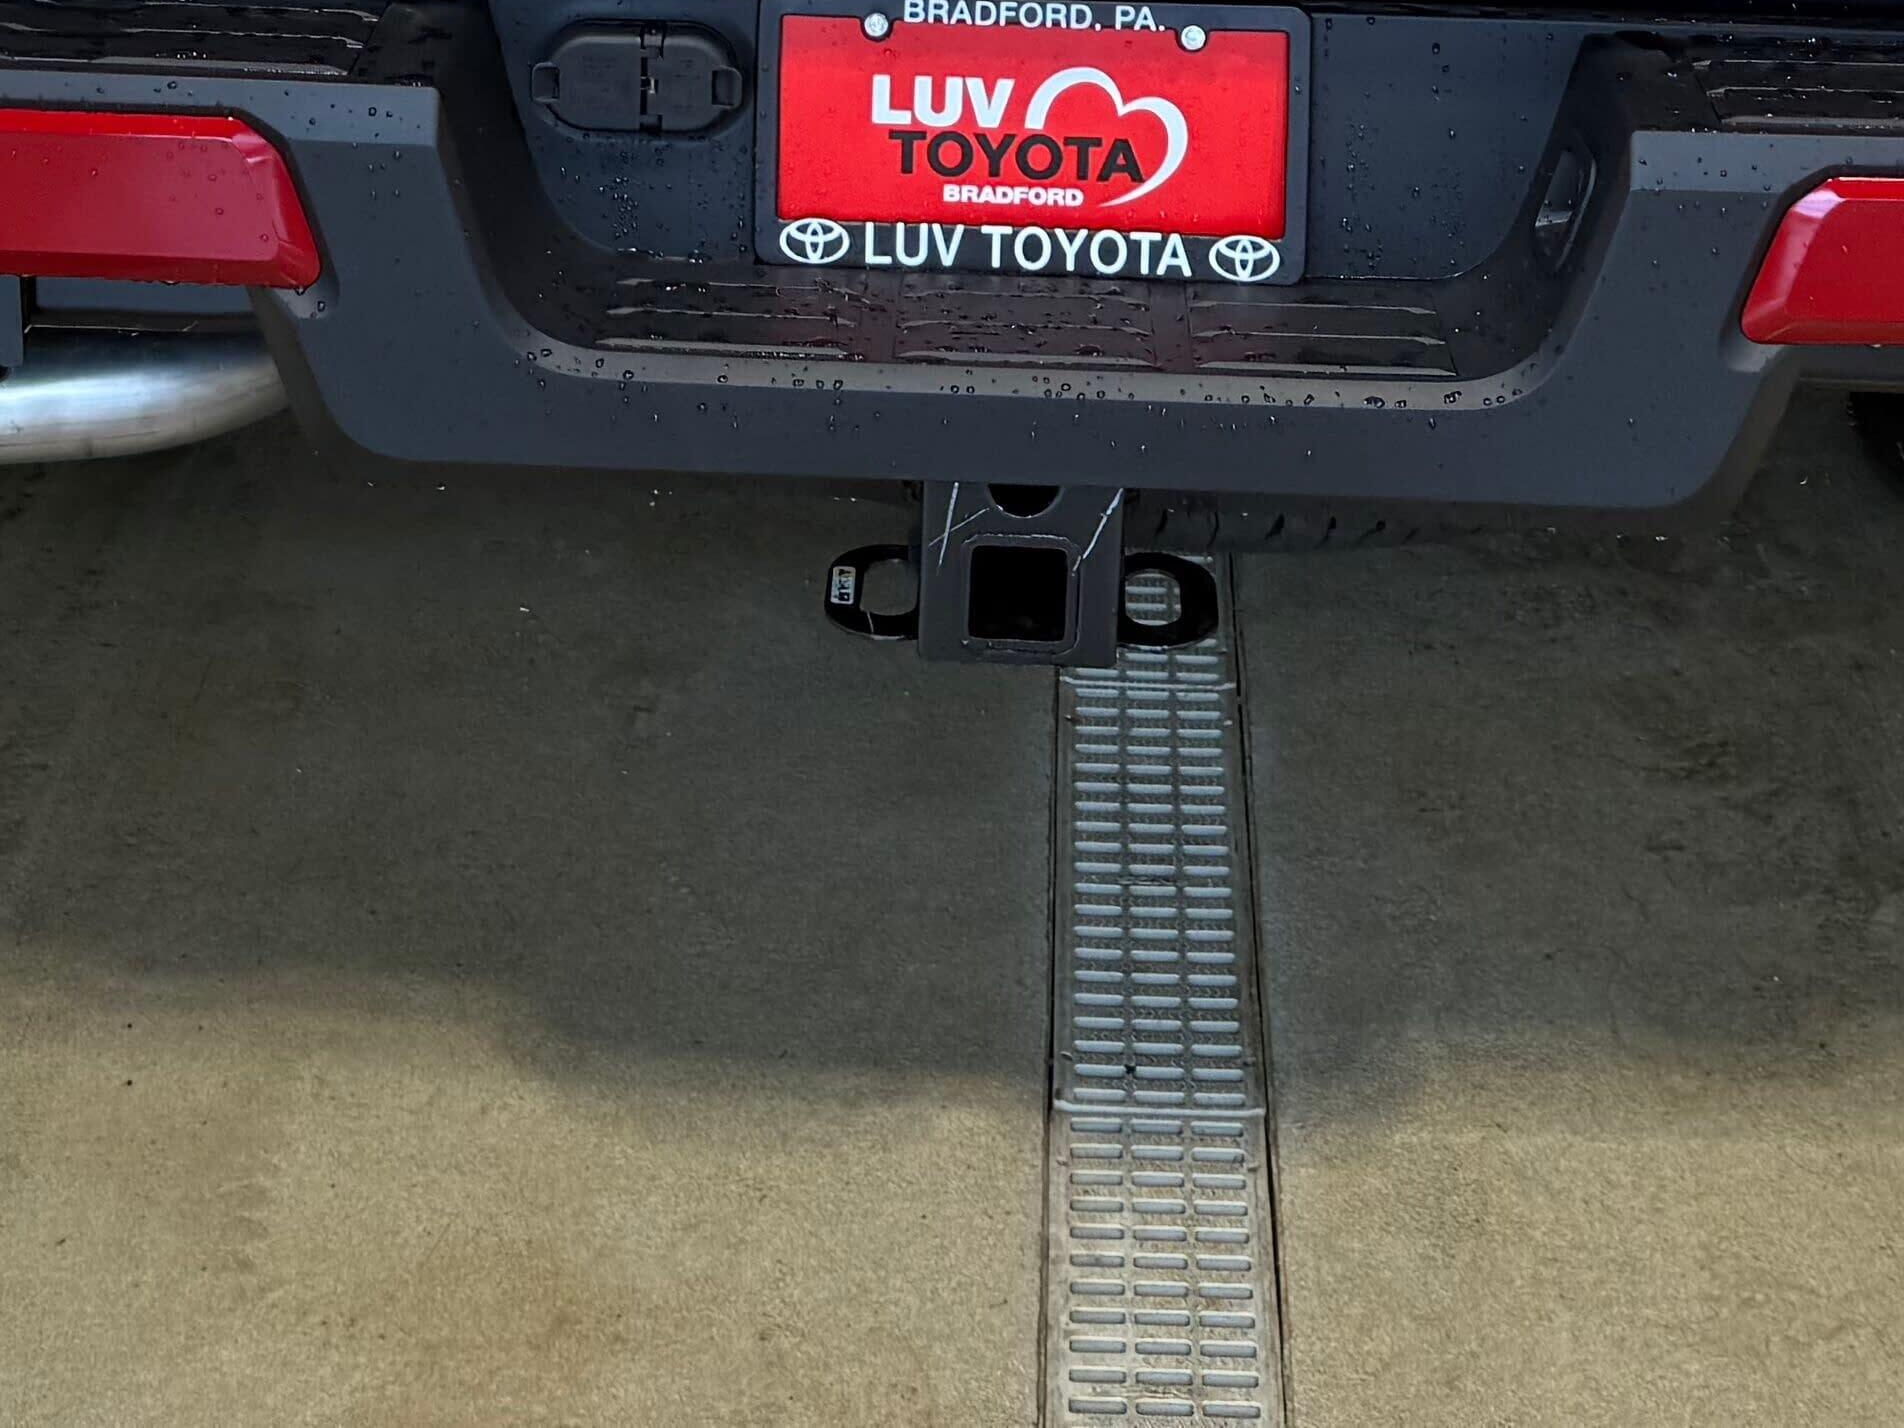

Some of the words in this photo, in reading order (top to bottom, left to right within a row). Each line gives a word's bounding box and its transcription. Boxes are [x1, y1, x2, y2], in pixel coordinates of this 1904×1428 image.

[1115, 5, 1167, 33] PA.
[871, 74, 1015, 128] LUV
[888, 129, 1144, 183] TOYOTA
[942, 183, 1084, 207] BRADFORD
[864, 221, 966, 267] LUV
[980, 225, 1193, 278] TOYOTA
